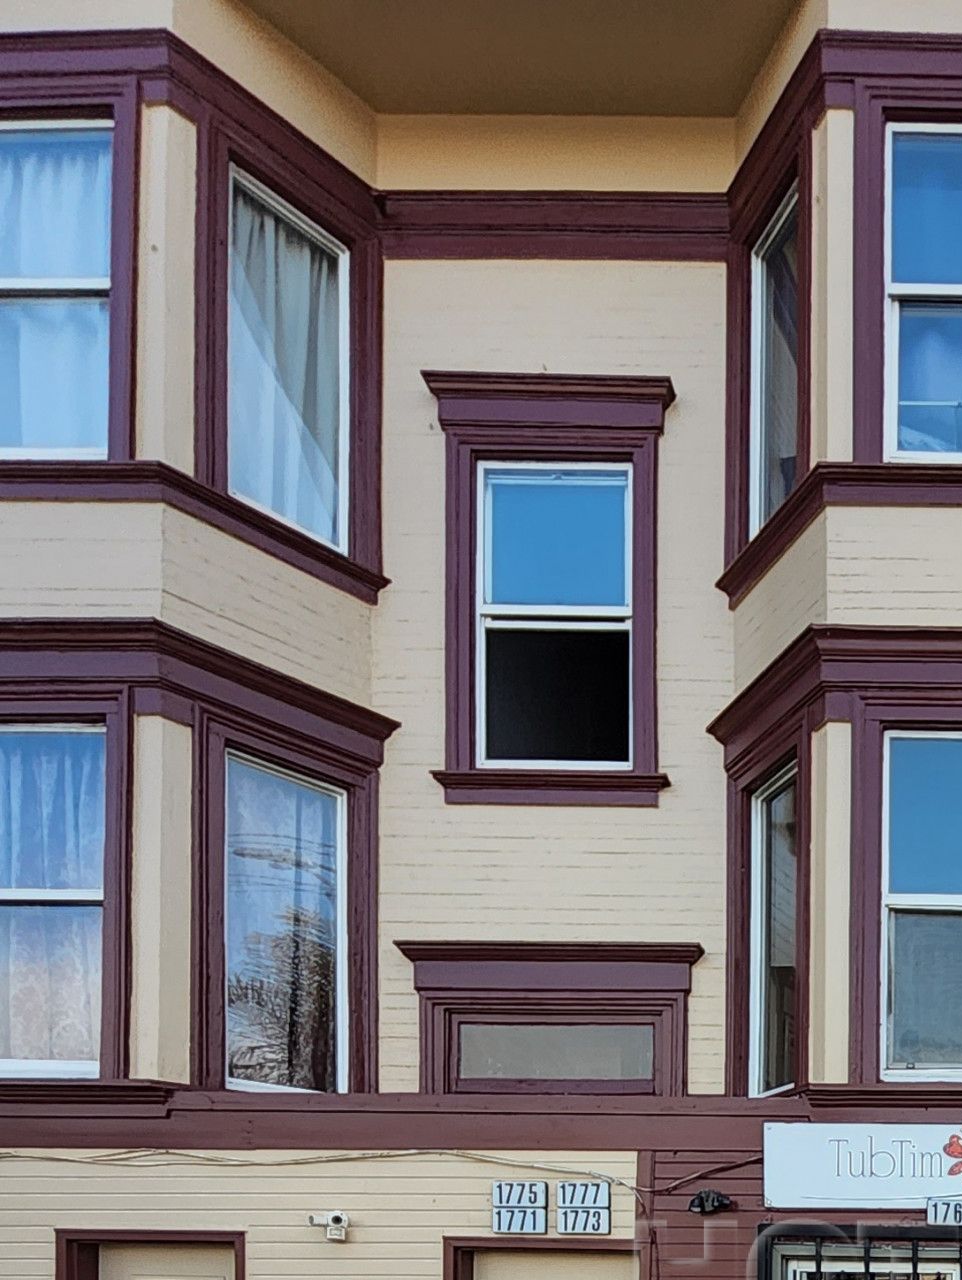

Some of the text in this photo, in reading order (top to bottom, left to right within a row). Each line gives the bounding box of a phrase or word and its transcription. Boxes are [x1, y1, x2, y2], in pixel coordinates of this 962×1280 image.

[828, 1136, 943, 1179] TubTim
[496, 1183, 538, 1205] 1775
[560, 1183, 601, 1205] 1777
[495, 1210, 538, 1232] 1771
[561, 1210, 602, 1232] 1773
